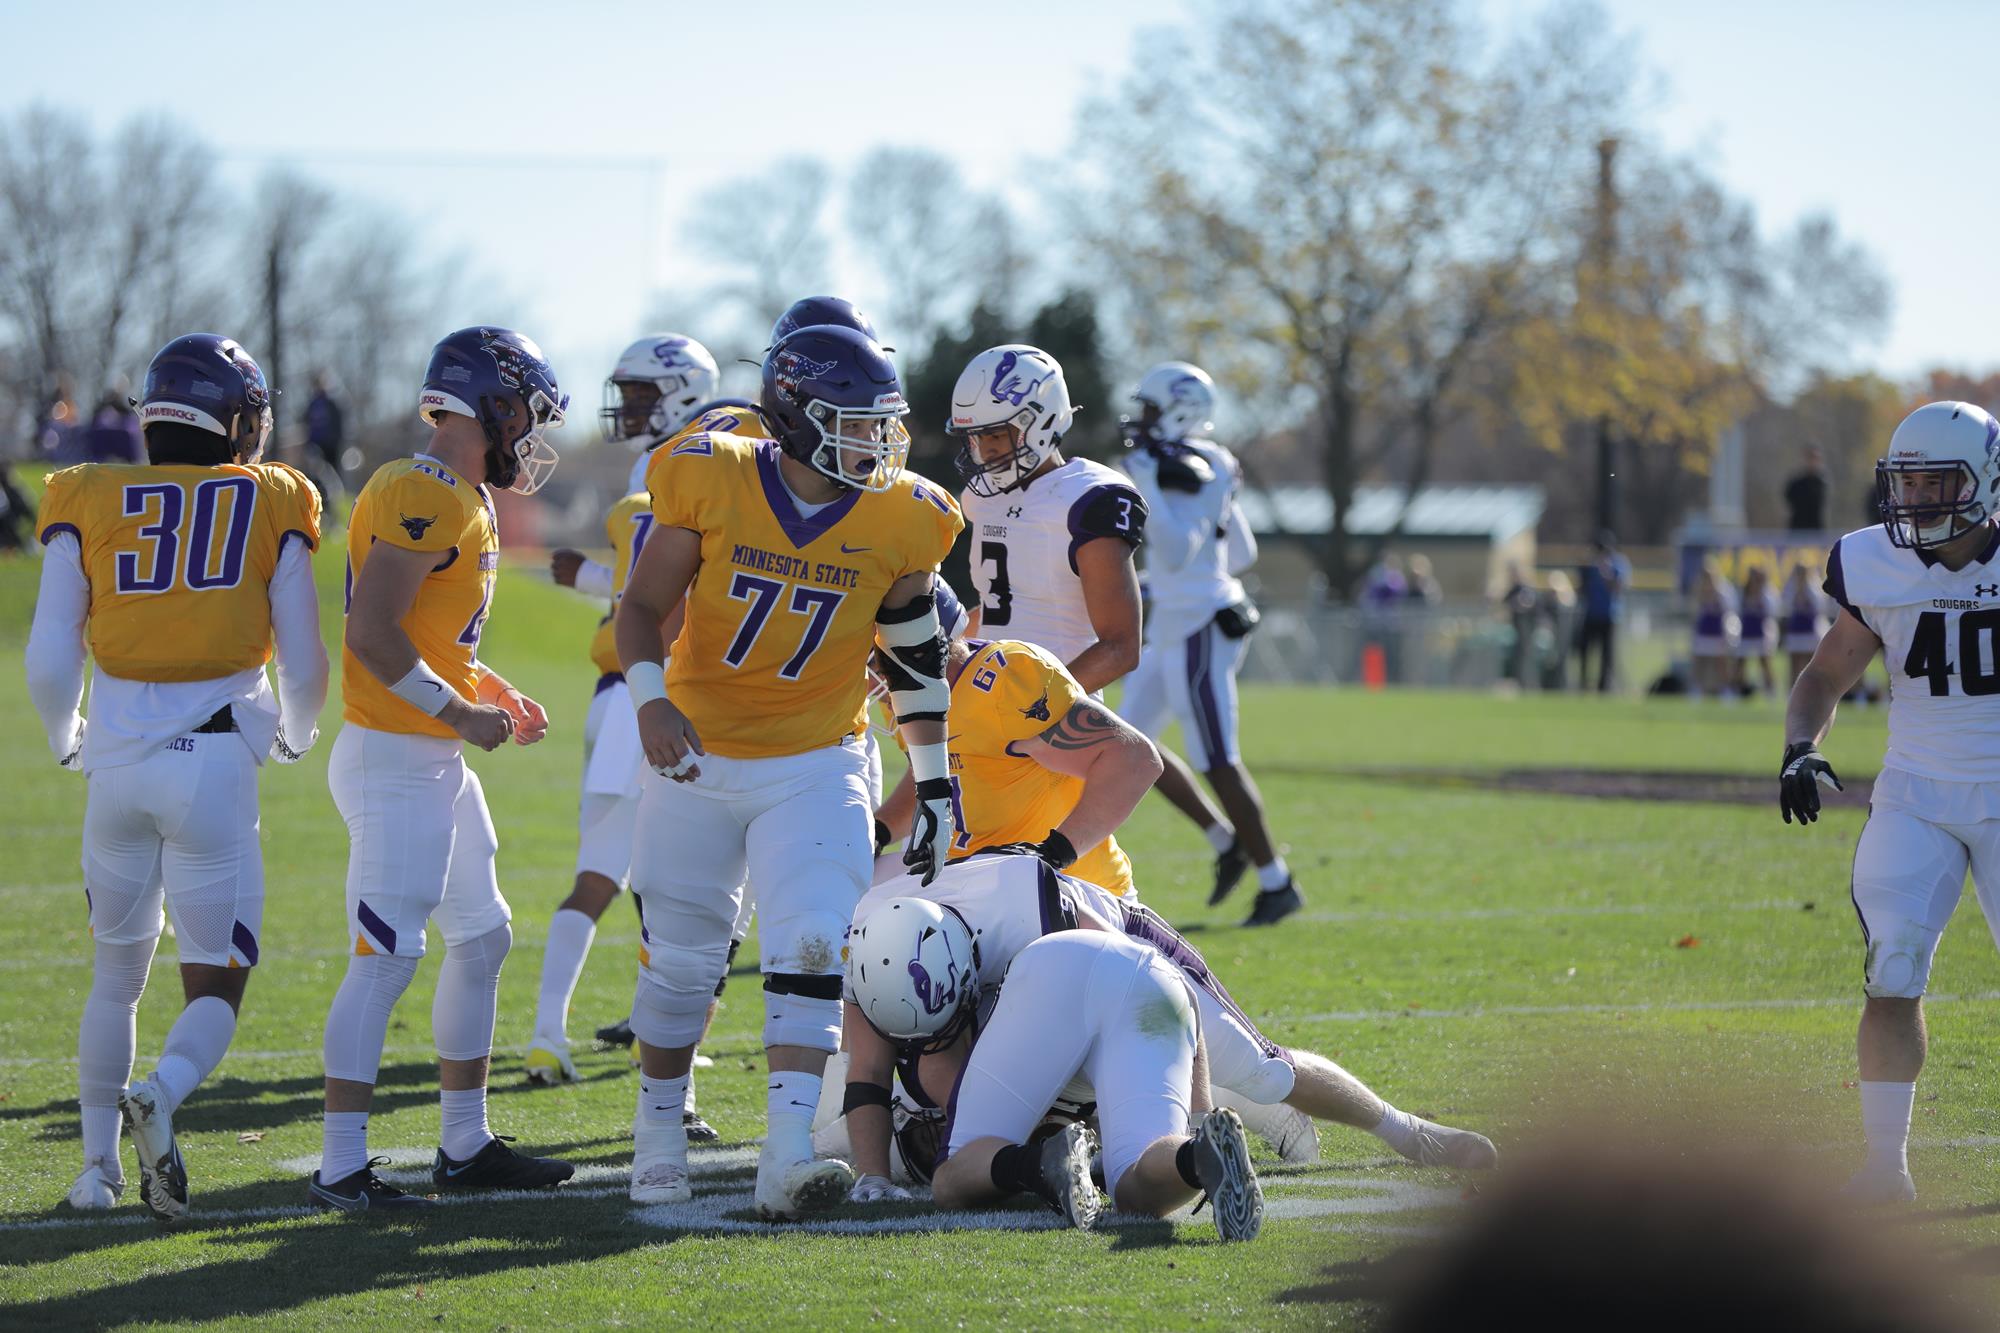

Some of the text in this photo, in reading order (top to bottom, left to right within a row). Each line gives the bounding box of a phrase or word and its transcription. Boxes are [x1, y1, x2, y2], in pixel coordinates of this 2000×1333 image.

[115, 476, 258, 595] 30
[982, 525, 1008, 538] COUGARS
[1115, 496, 1132, 531] 3
[731, 544, 860, 588] MINNESOTA STATE
[980, 541, 1013, 626] 3
[722, 571, 849, 680] 77
[1932, 598, 1980, 610] COUGARS
[972, 648, 1008, 693] 67
[1904, 611, 2000, 697] 40
